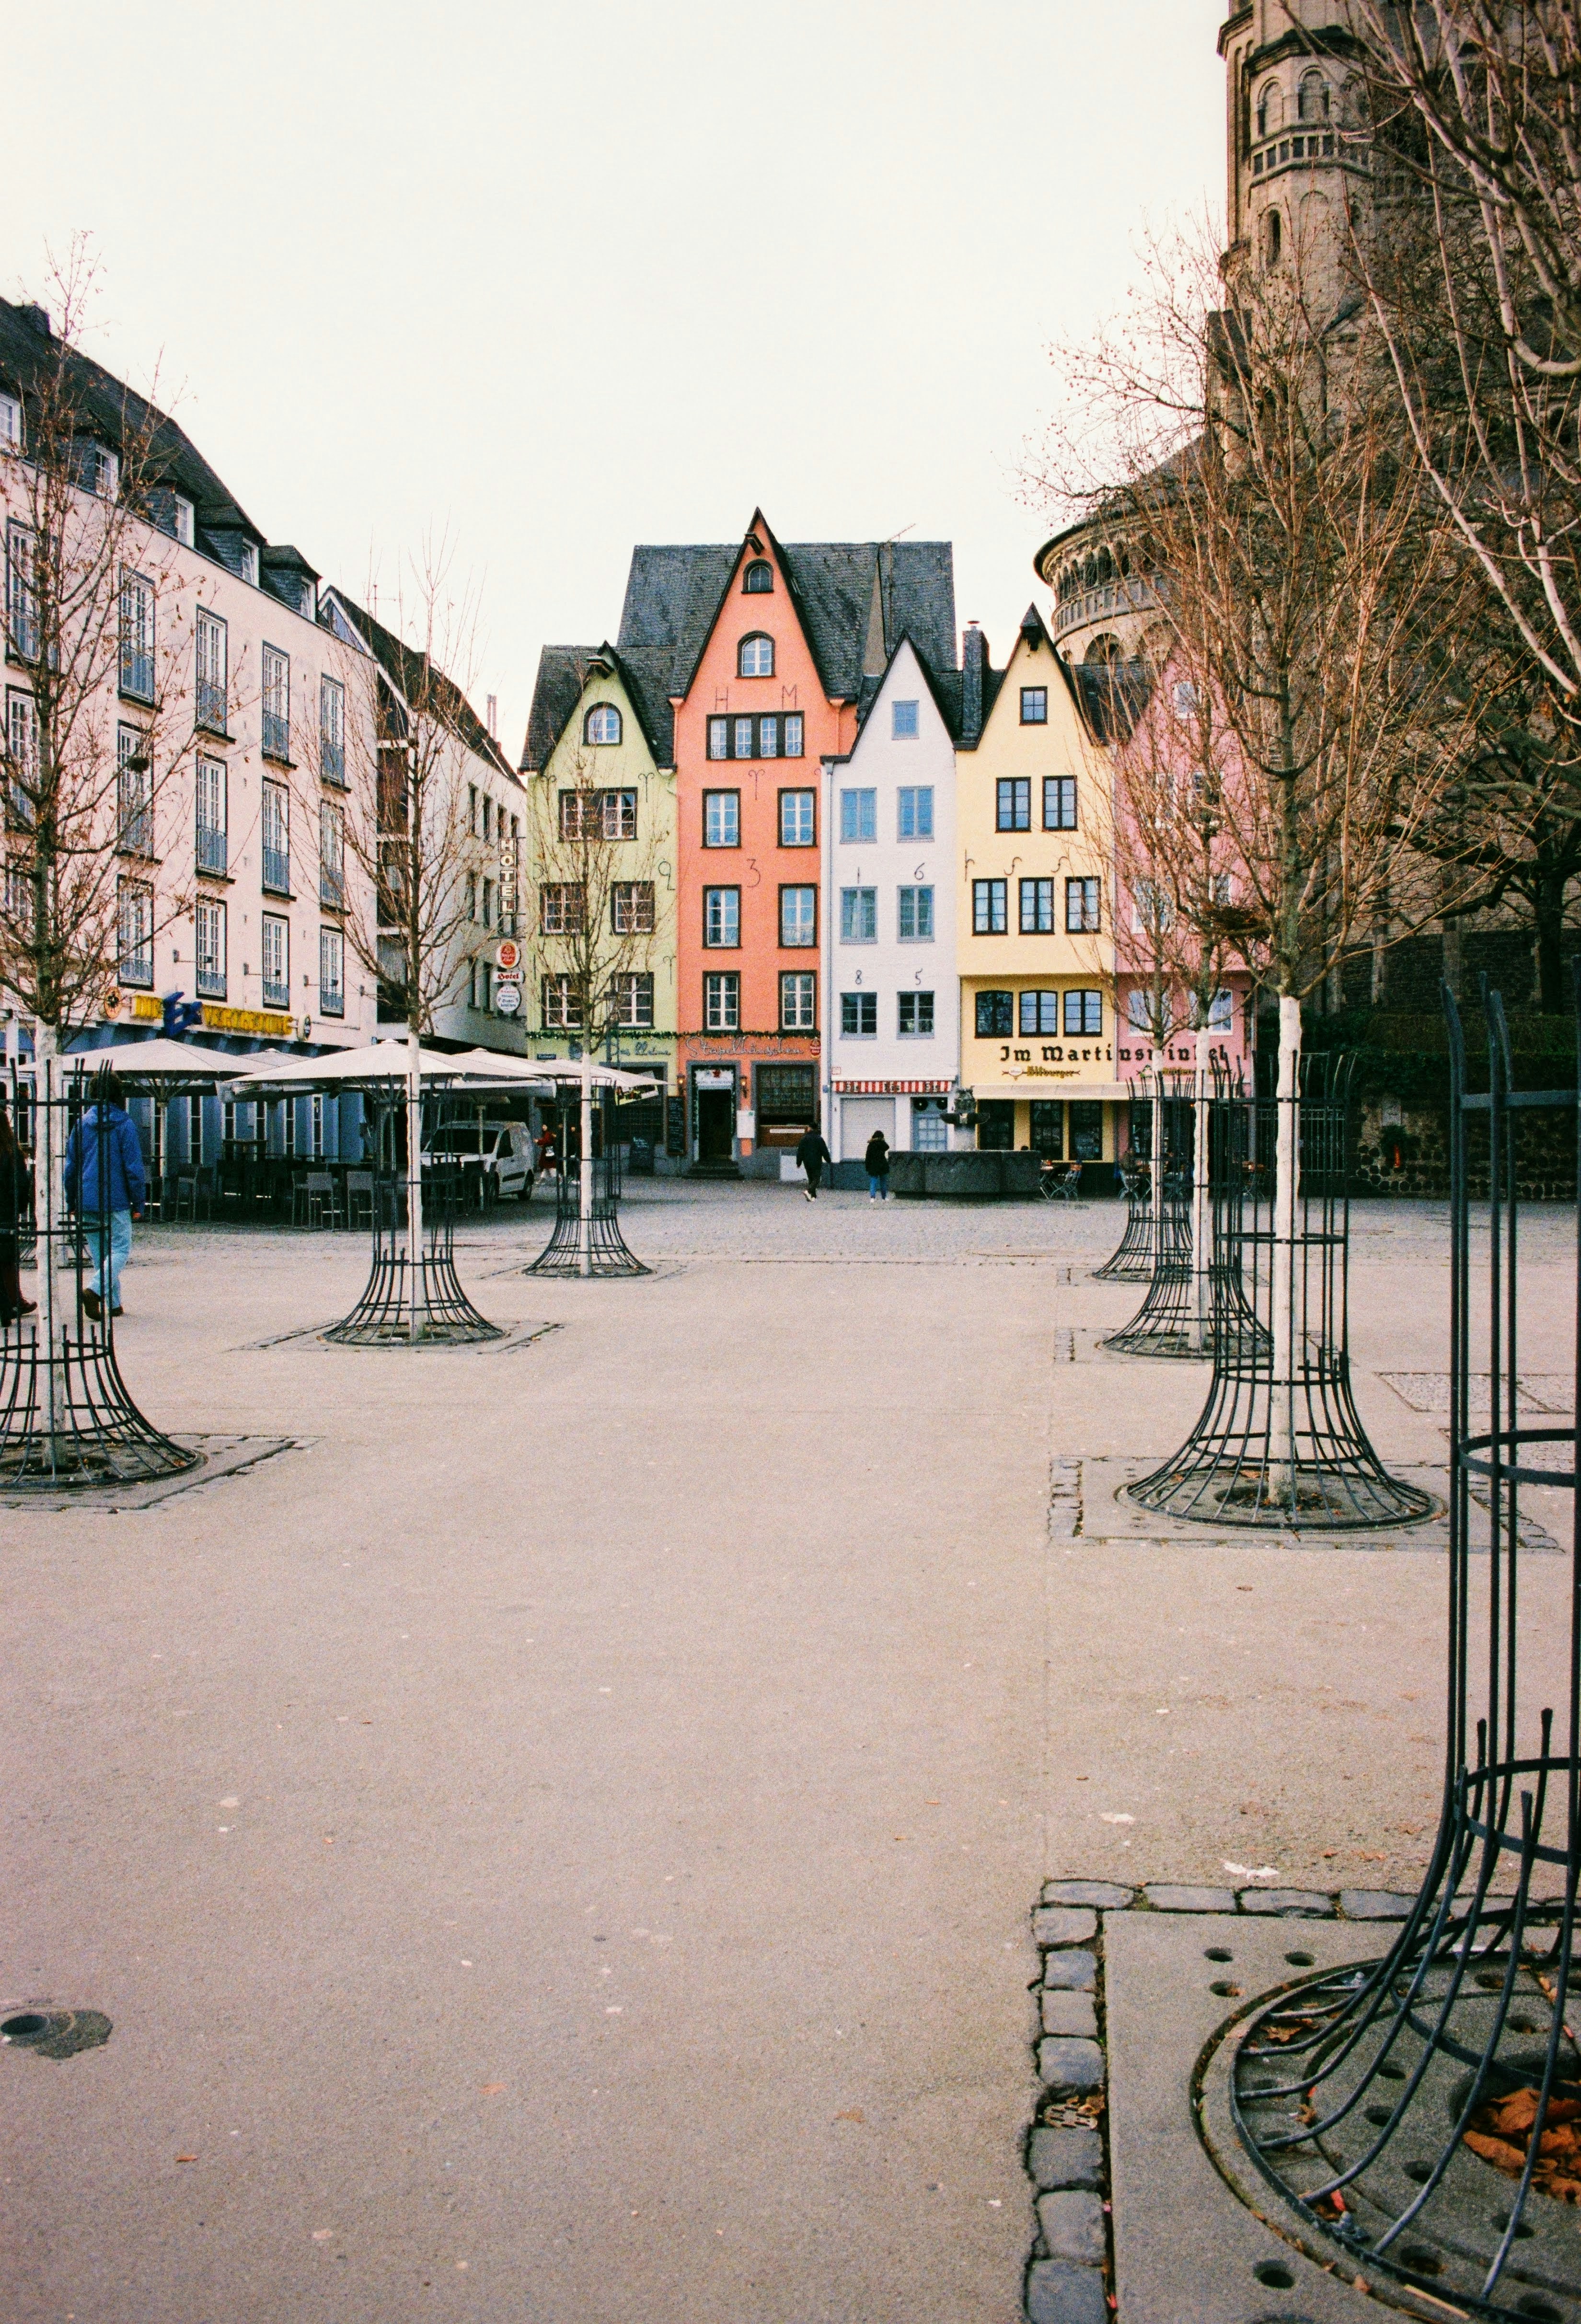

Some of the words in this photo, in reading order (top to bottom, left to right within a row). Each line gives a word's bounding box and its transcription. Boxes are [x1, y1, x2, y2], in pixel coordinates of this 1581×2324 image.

[500, 839, 515, 913] HOTEL
[913, 862, 926, 881] 6
[854, 969, 863, 986] 8
[914, 967, 923, 986] 5
